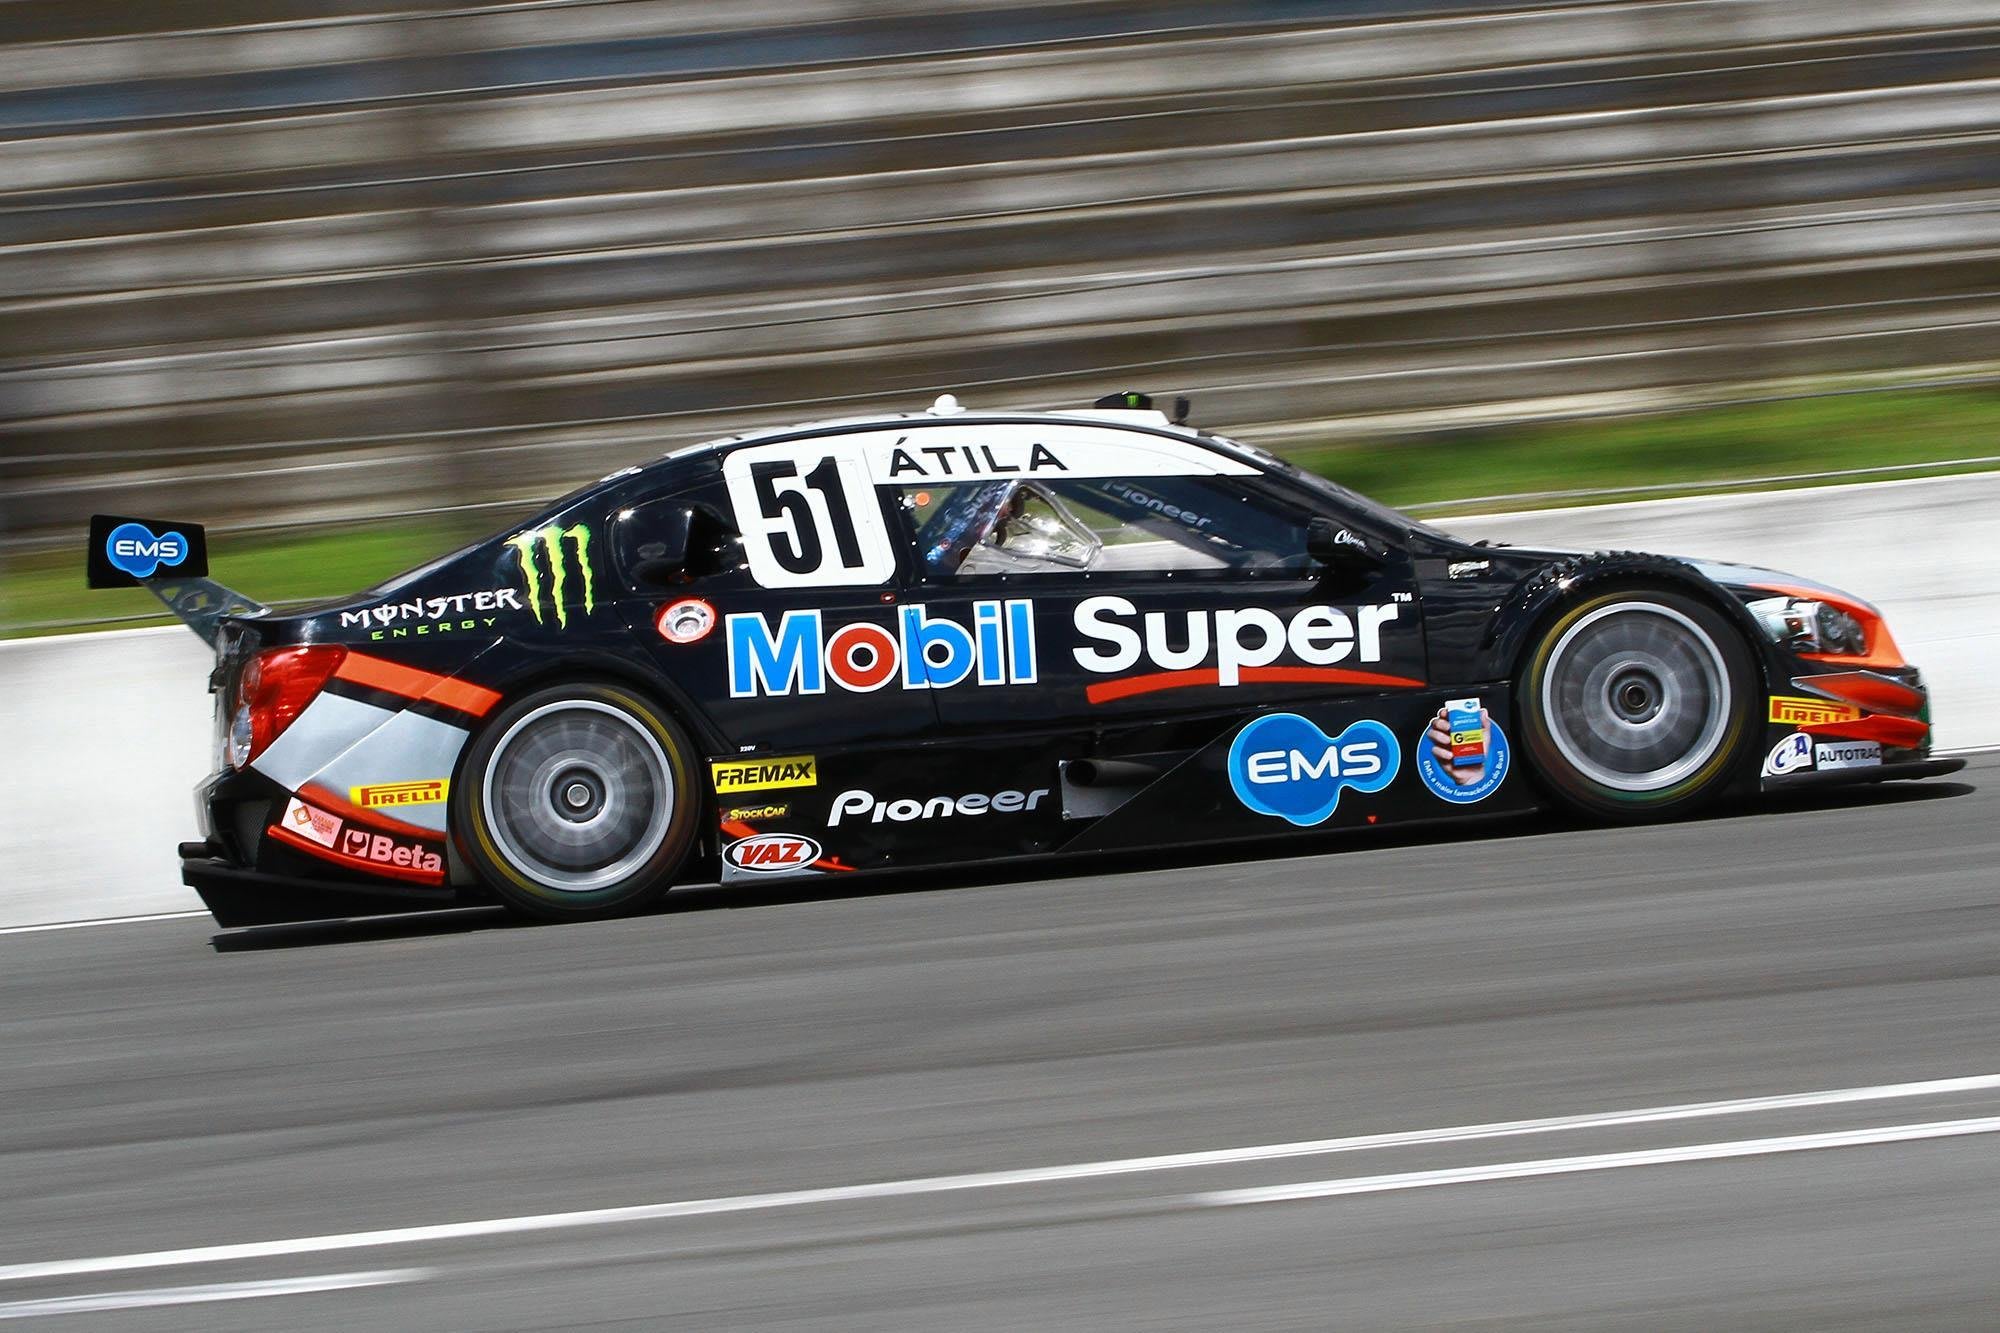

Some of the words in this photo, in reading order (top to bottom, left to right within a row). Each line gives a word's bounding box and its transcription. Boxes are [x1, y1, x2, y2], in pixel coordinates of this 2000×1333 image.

[889, 437, 1068, 478] ÁTILA
[750, 456, 865, 575] 51
[115, 539, 179, 559] EMS
[371, 617, 496, 641] ENERGY
[725, 598, 1038, 698] Mobil
[1072, 595, 1398, 687] Super
[1454, 733, 1464, 744] G
[716, 762, 813, 787] FREMAX
[1247, 742, 1382, 784] EMS
[360, 782, 442, 807] PIRELLI
[827, 789, 1050, 827] Pioneer
[370, 834, 442, 872] Beta
[740, 842, 804, 866] VAZ
